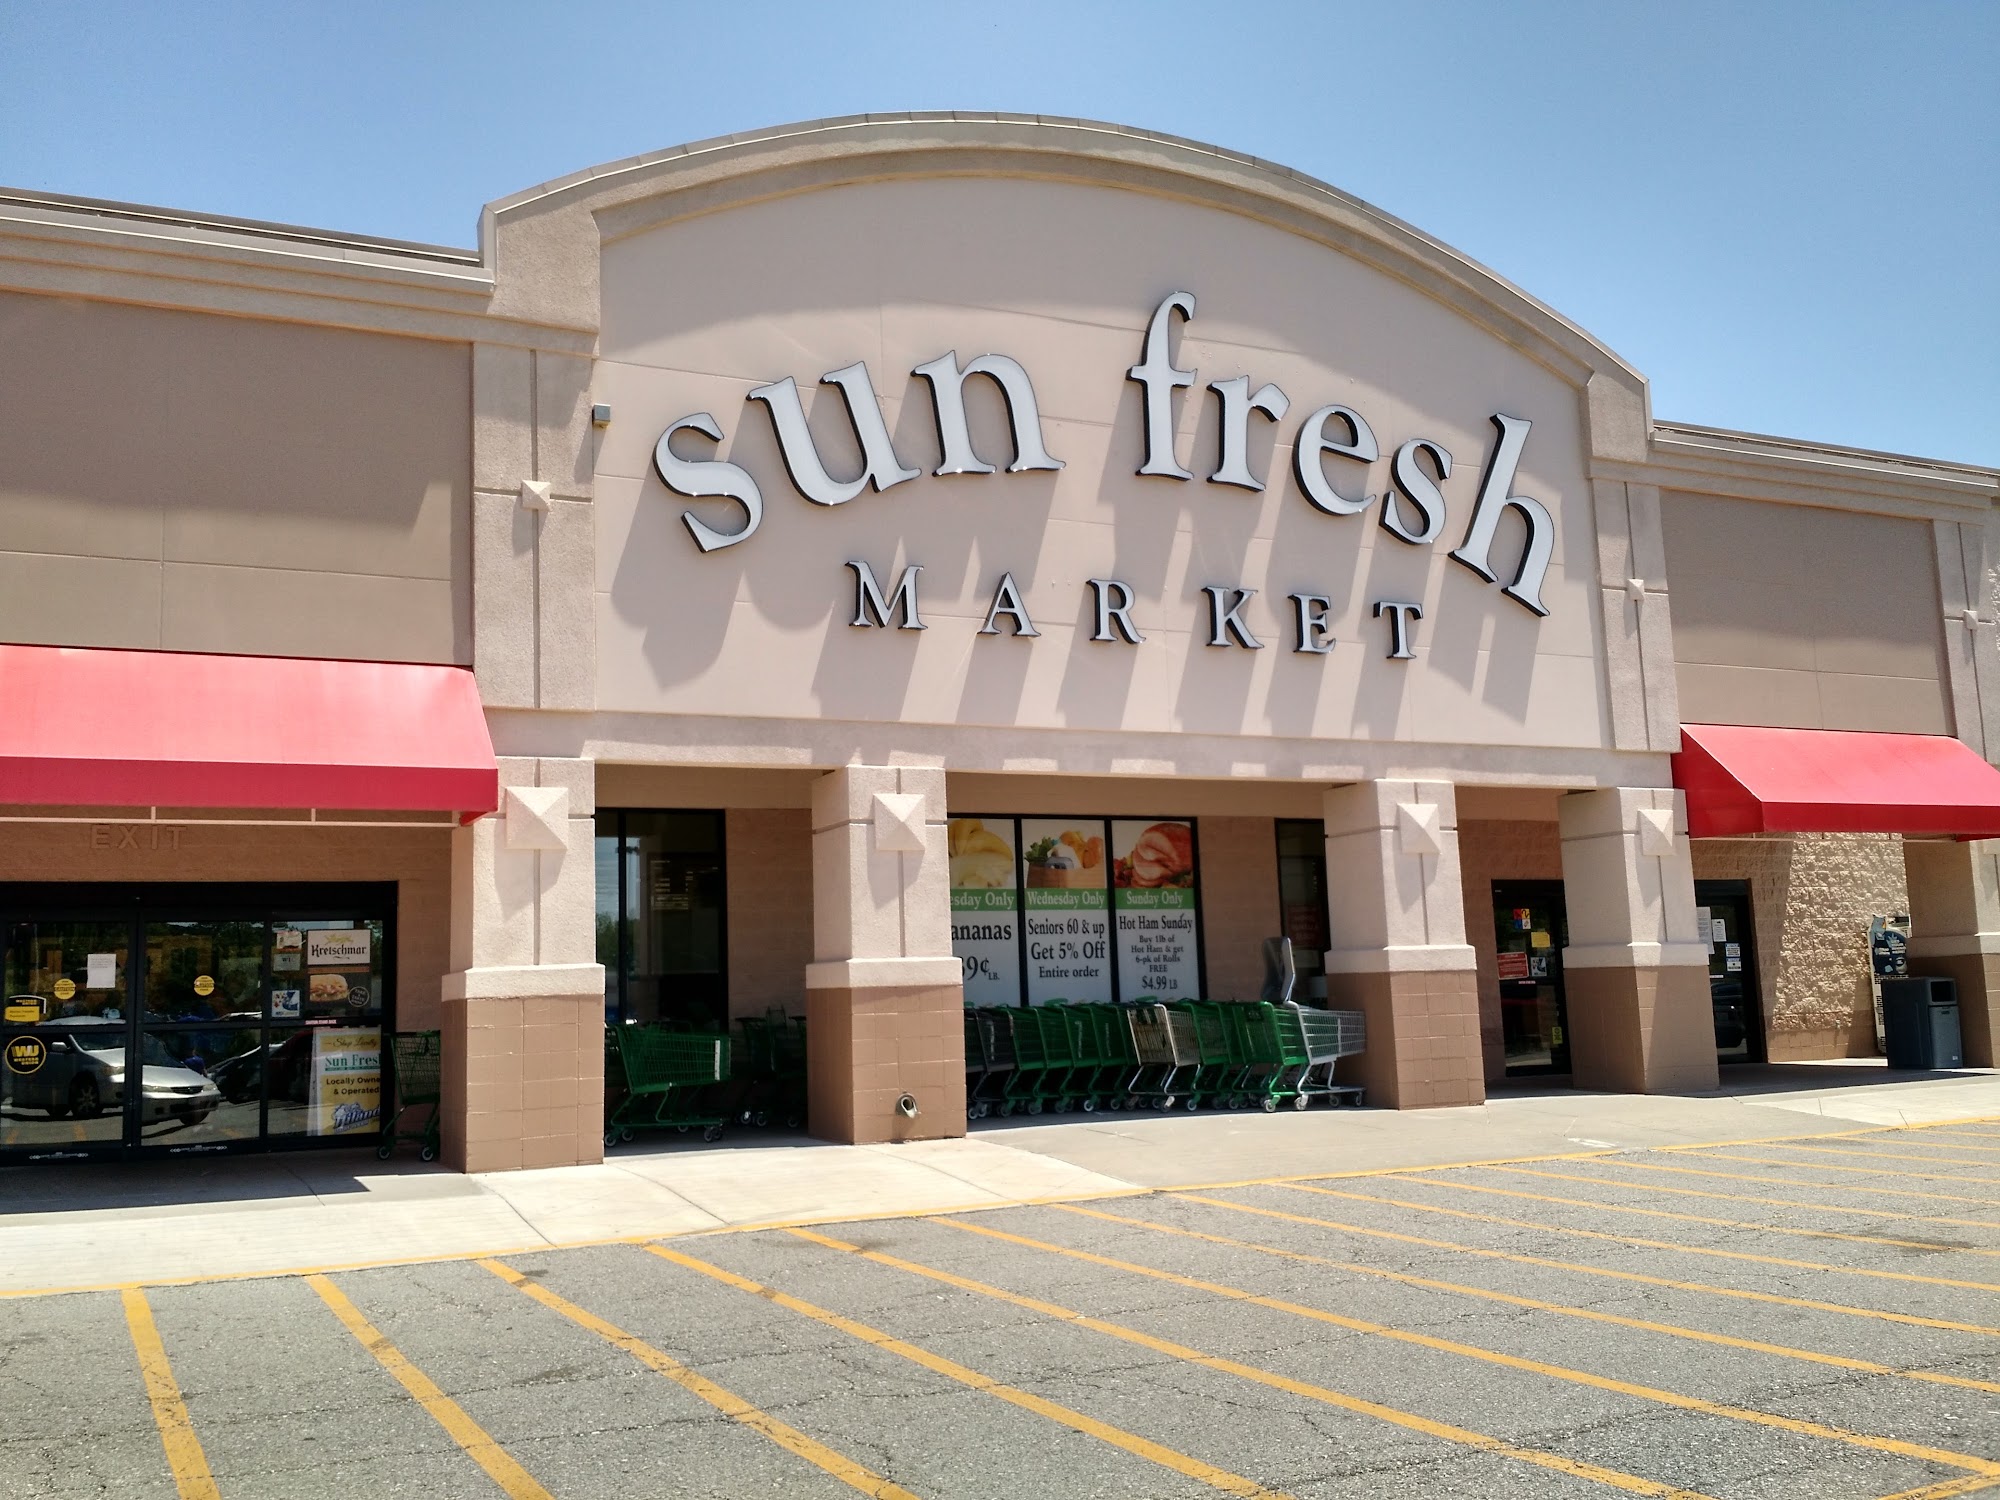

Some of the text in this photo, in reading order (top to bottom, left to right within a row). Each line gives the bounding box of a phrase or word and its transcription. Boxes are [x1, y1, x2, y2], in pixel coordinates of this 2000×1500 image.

[654, 291, 1556, 617] sun fresh
[845, 560, 1425, 660] MARKET
[90, 823, 187, 849] EXIT
[950, 892, 1014, 910] esday Only
[1027, 890, 1105, 909] Wednesday Only
[1126, 890, 1184, 908] Sunday Only
[1028, 917, 1105, 939] Seniors 60 & up
[1119, 912, 1193, 934] Hot Ham Sunday
[951, 924, 1012, 941] ananas
[1139, 934, 1152, 943] Buy
[1168, 934, 1175, 942] of
[311, 944, 367, 958] Kretschmar
[1031, 941, 1106, 960] Get 5% Off
[1131, 945, 1144, 953] Hot
[1146, 945, 1163, 953] Ham
[1173, 945, 1184, 955] get
[1135, 954, 1181, 965] 6-pk of Rolls
[1039, 965, 1099, 978] Entire order
[1149, 964, 1168, 973] FREE
[1142, 975, 1178, 990] $4.99 LB
[325, 1056, 348, 1067] Sun
[326, 1077, 355, 1086] Locally
[341, 1086, 380, 1096] Operated
